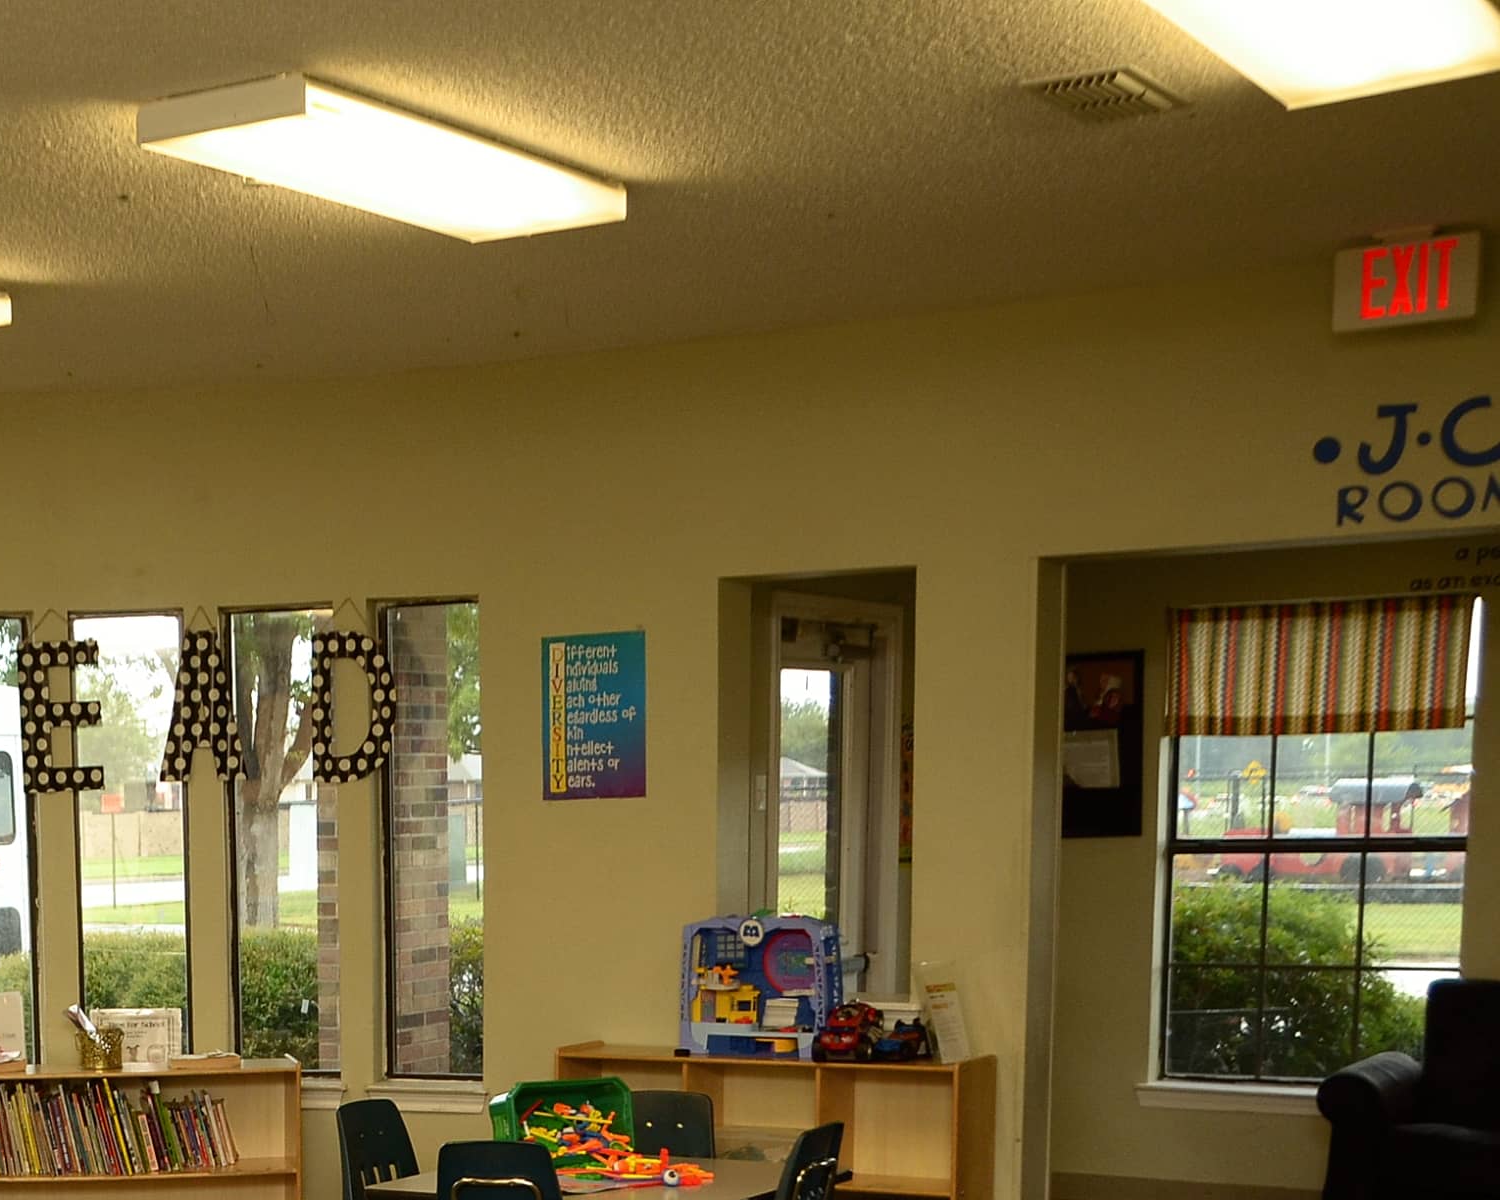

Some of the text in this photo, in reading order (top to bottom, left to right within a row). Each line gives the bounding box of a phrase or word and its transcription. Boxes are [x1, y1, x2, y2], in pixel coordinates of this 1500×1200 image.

[1360, 238, 1460, 321] EXIT
[588, 691, 621, 708] other
[552, 647, 564, 790] DIVERSITY
[621, 706, 636, 721] of
[607, 758, 620, 771] or
